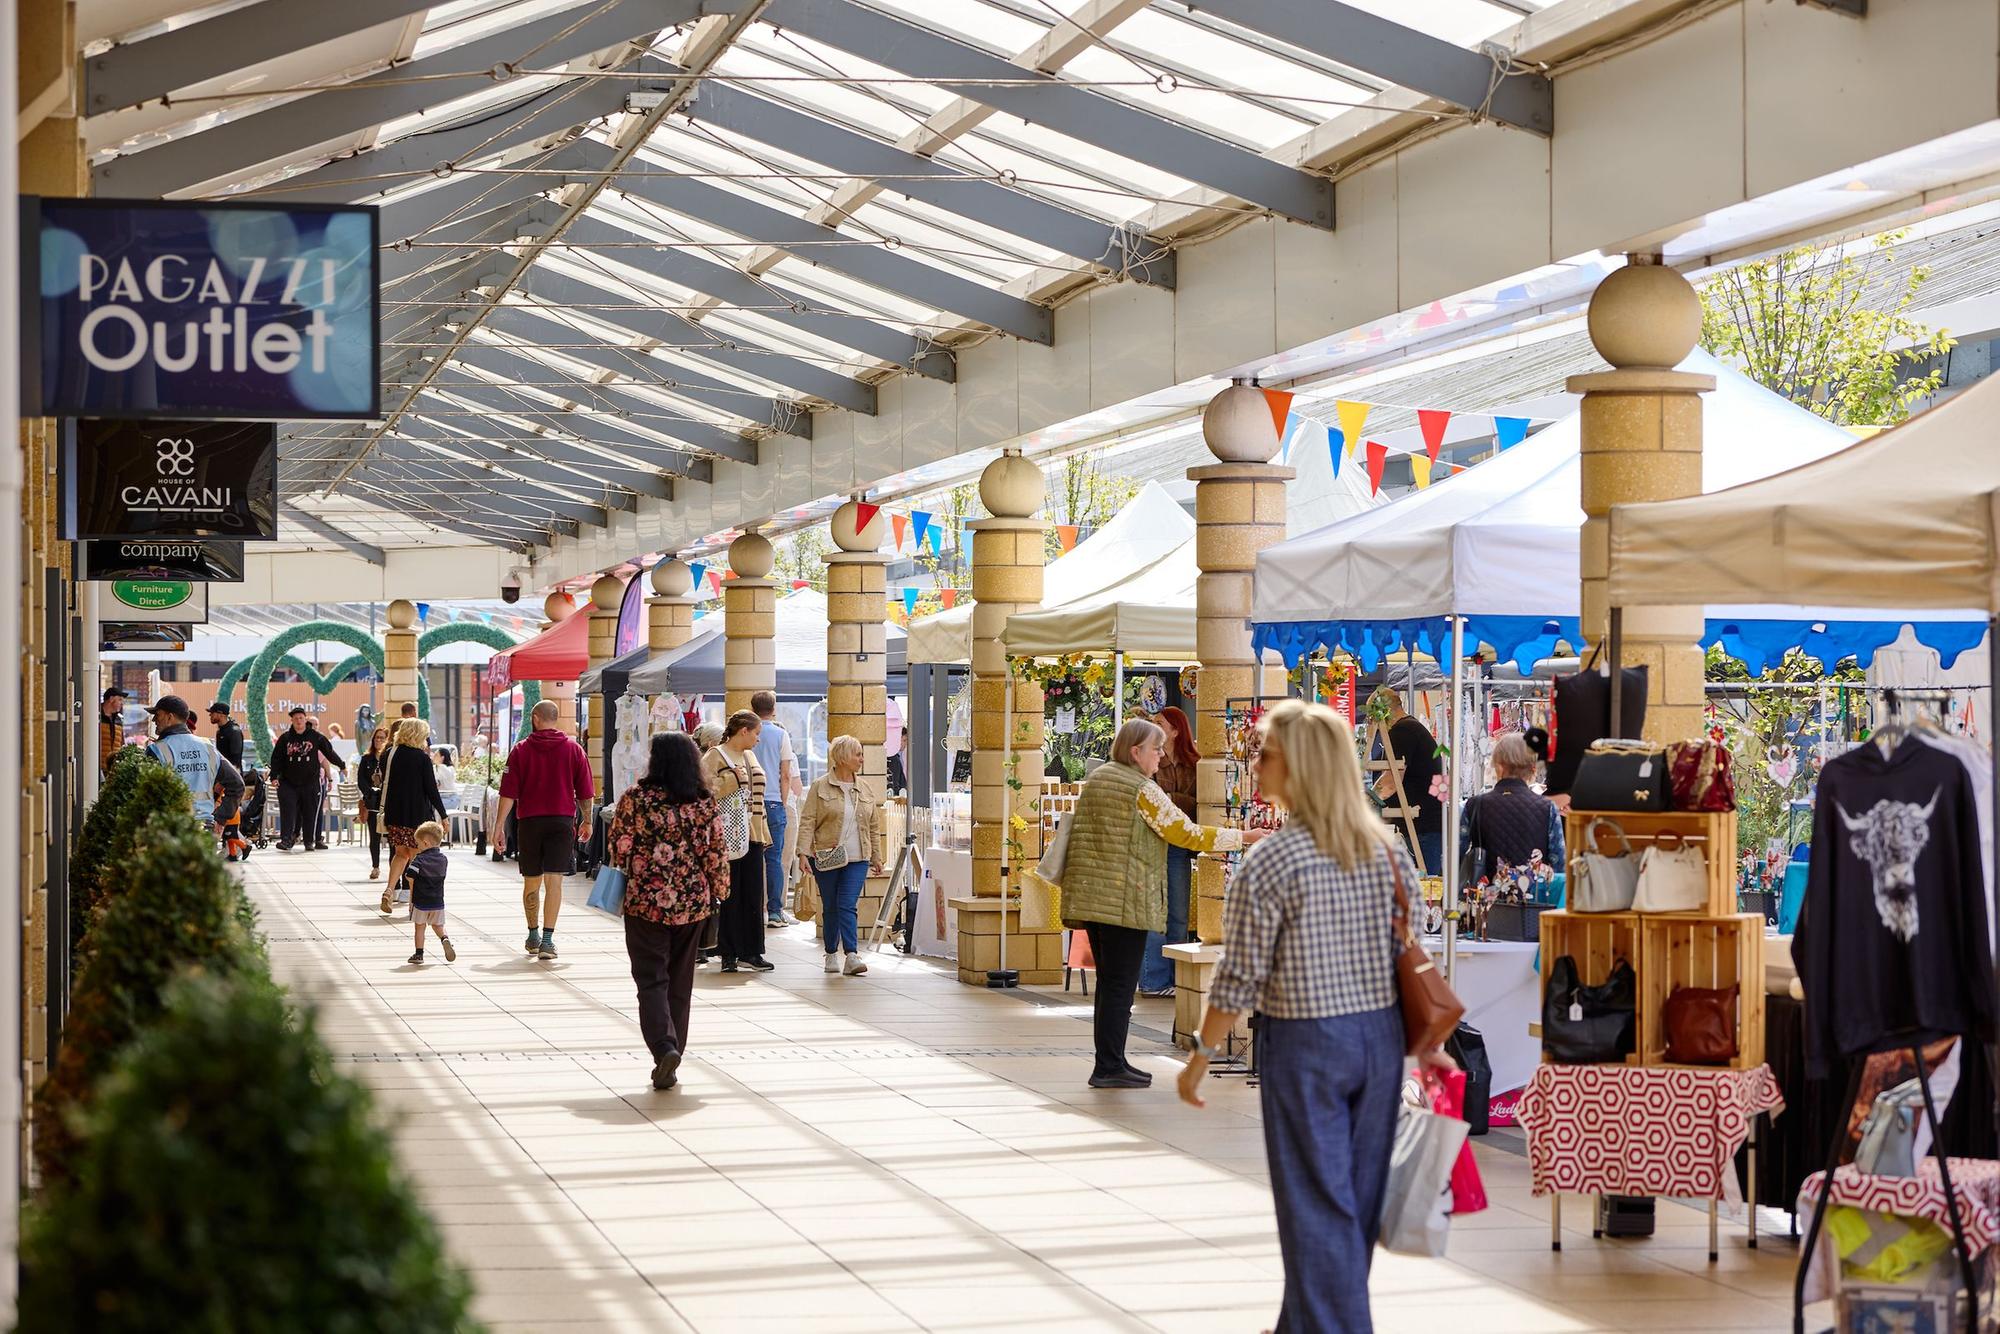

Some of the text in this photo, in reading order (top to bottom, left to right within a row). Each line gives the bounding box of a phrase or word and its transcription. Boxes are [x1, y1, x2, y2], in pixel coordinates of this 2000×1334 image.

[79, 253, 338, 304] PAGAZZI
[79, 304, 335, 374] Outlet
[121, 486, 231, 506] CAVANI
[121, 543, 203, 562] company
[132, 585, 173, 593] Furniture
[139, 597, 166, 605] Direct
[180, 750, 202, 760] GUEST
[177, 762, 208, 773] SERVICES
